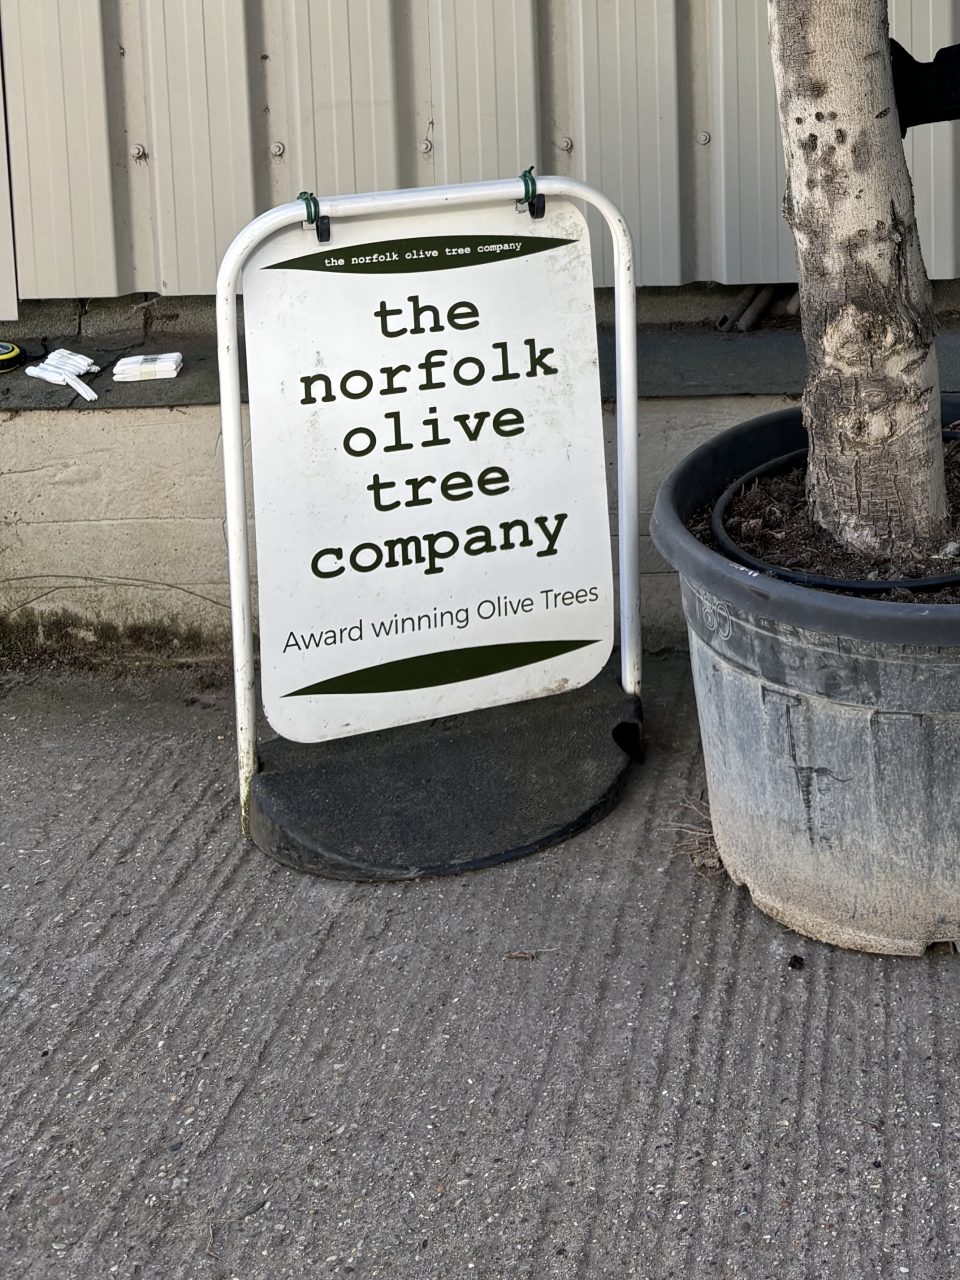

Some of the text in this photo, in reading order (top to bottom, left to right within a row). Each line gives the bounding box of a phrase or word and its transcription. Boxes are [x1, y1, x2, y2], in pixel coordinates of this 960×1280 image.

[324, 241, 522, 267] the norfolk olive tree company
[373, 295, 480, 339] the
[299, 338, 559, 406] norfolk
[342, 407, 525, 458] olive
[366, 466, 510, 512] tree
[310, 512, 569, 579] company
[282, 586, 599, 654] Award winning Olive Trees
